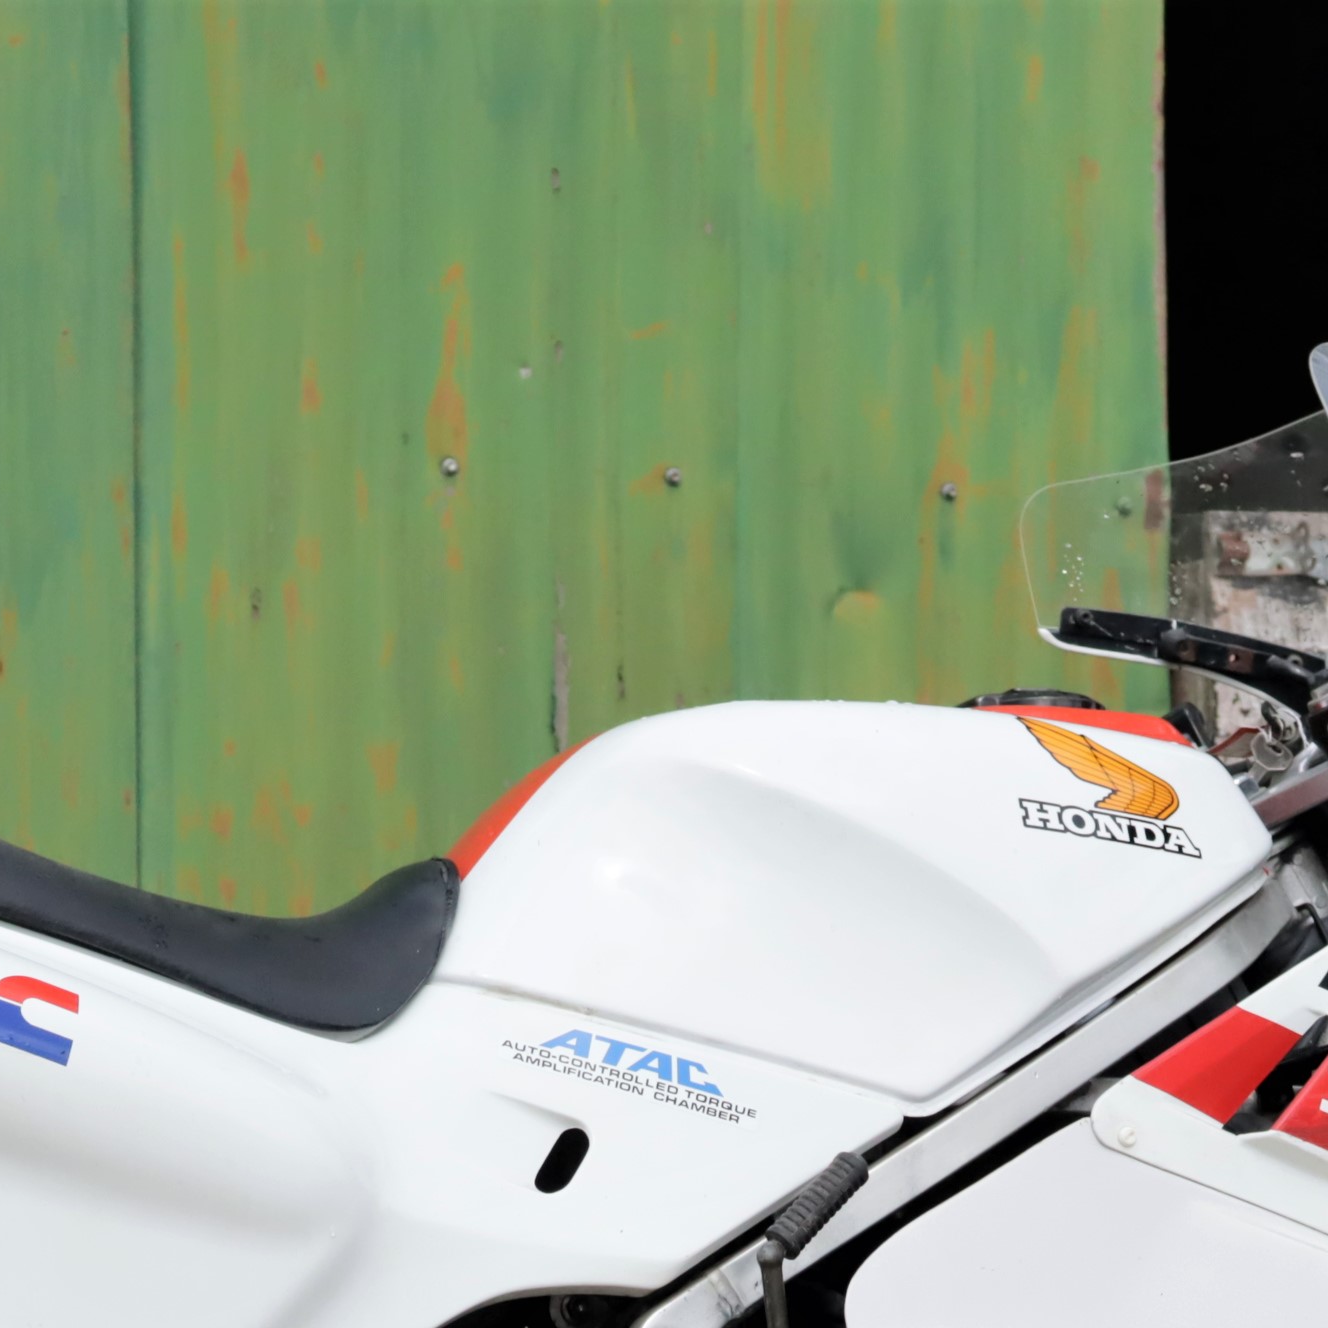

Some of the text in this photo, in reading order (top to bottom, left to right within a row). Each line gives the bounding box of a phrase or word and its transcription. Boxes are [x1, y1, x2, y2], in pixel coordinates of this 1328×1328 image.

[1018, 798, 1202, 859] HONDA
[502, 1039, 757, 1119] AUTO-CONTROLLED TORQUE
[513, 1053, 741, 1124] AMPLIFICATION CHAMBER
[540, 1029, 724, 1097] ATAC
